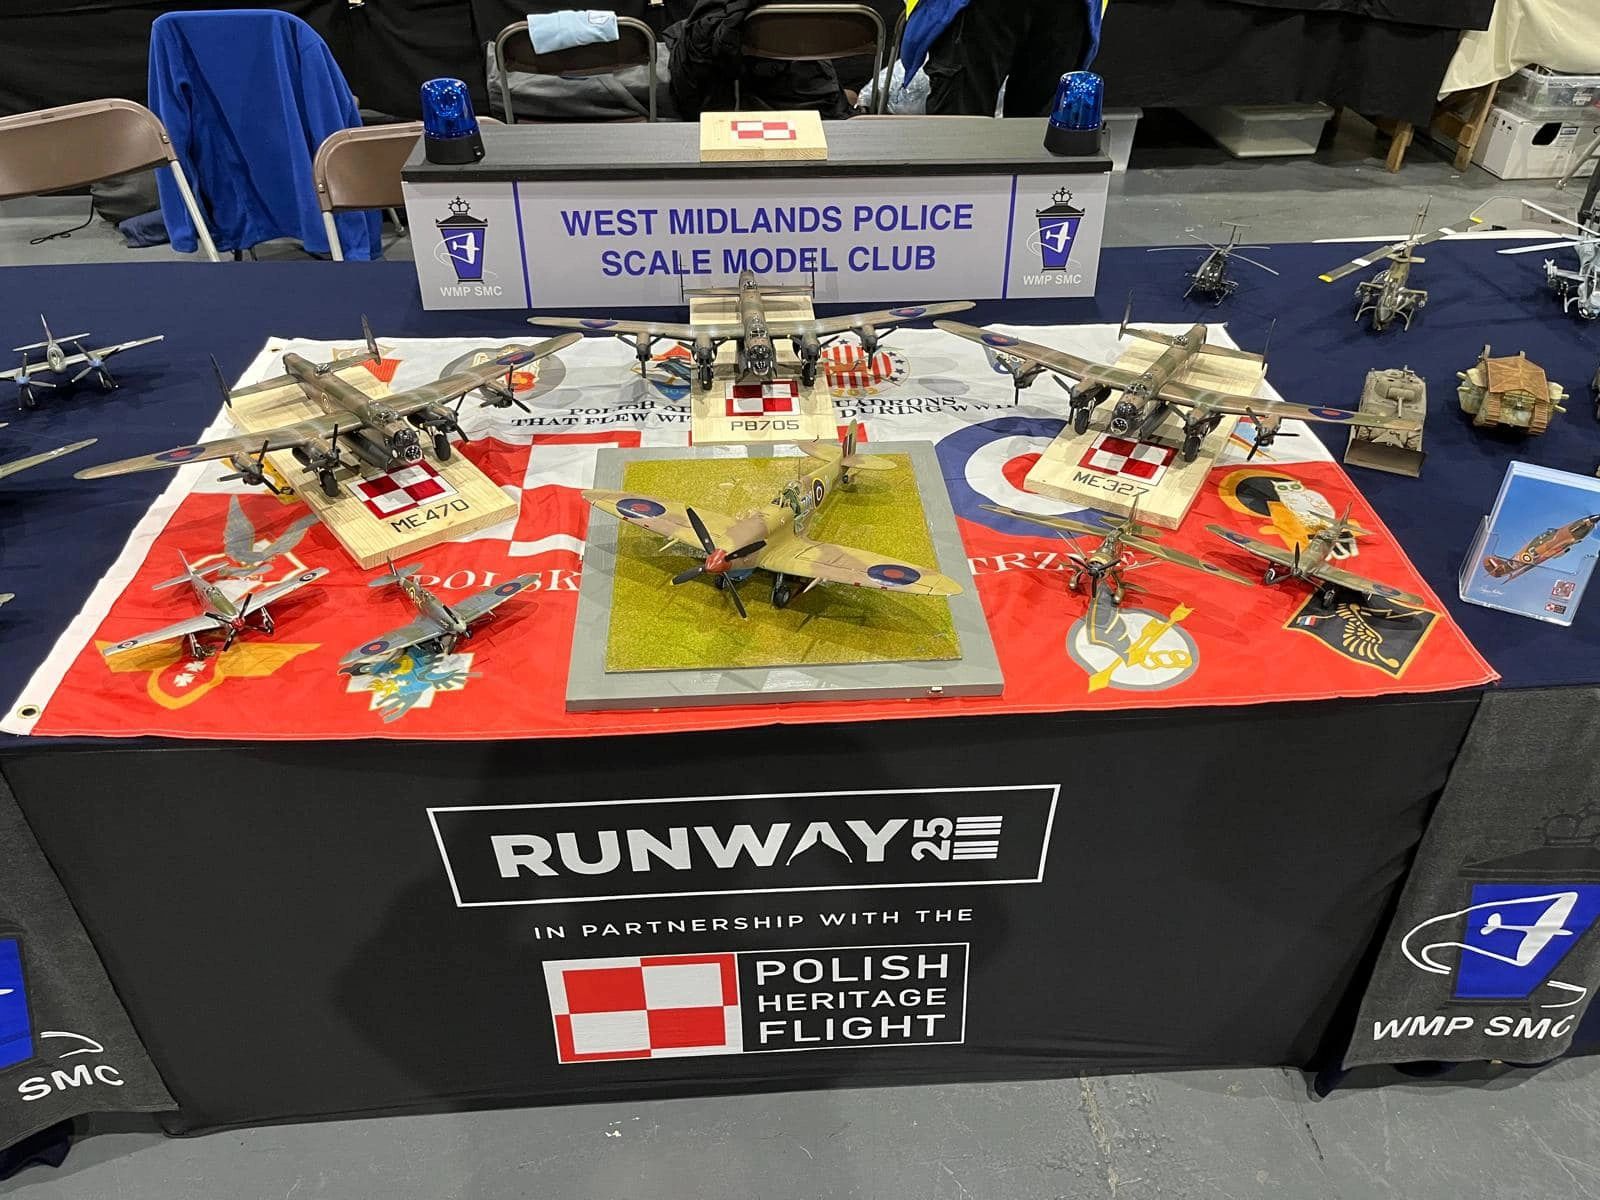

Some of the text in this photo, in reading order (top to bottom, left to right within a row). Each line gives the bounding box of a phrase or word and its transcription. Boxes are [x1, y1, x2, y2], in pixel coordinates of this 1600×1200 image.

[561, 204, 973, 236] WEST MIDLANDS POLICE
[602, 245, 936, 276] SCALE MODEL CLUB
[440, 286, 502, 297] WMP SMC
[1023, 274, 1082, 286] WMP SMC
[511, 417, 579, 427] THAT
[585, 412, 649, 425] FLEW
[840, 405, 941, 418] DURING
[832, 396, 956, 408] UADRONS
[731, 420, 800, 431] PB705
[1072, 471, 1150, 497] ME327
[390, 499, 470, 533] ME470
[490, 817, 953, 878] RUNWAY 25
[534, 909, 973, 940] IN PARTNERSHIP WITH THE
[756, 953, 948, 986] POLISH
[758, 987, 947, 1013] HERITAGE
[759, 1013, 946, 1044] FLIGHT
[1373, 1014, 1575, 1041] WMP SMC
[18, 1064, 125, 1101] SMC
